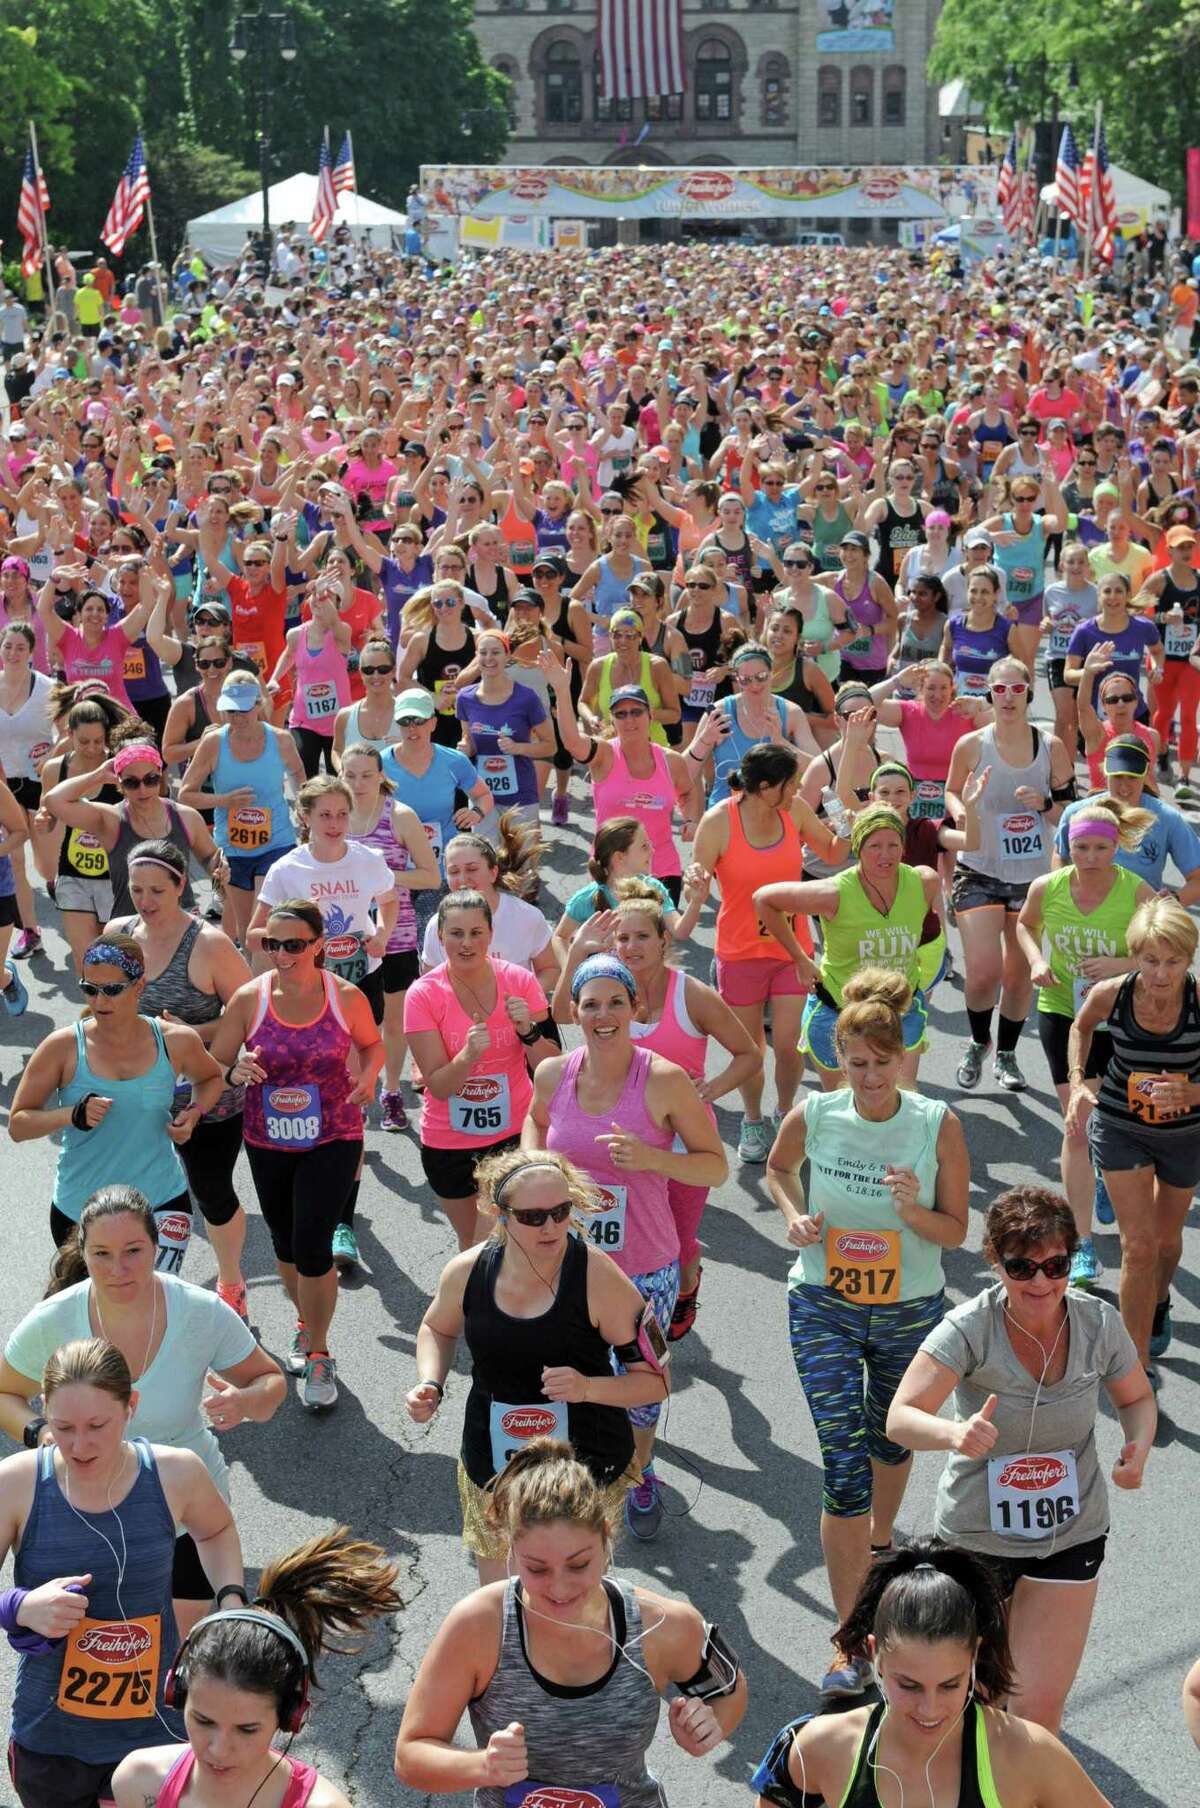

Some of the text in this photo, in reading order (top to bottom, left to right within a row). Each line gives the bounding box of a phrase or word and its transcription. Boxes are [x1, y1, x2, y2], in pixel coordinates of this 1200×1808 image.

[307, 697, 336, 715] 1167
[229, 827, 269, 845] 2616
[1002, 834, 1042, 854] 1024
[75, 851, 105, 870] 259
[310, 879, 360, 897] SNAIL
[865, 925, 911, 938] WE WILL
[1082, 926, 1109, 940] WILL
[858, 933, 918, 960] RUN
[1055, 932, 1117, 958] RUN
[459, 1105, 502, 1129] 765
[266, 1115, 320, 1141] 3008
[837, 1156, 867, 1171] Emily
[833, 1168, 851, 1180] FOR
[853, 1172, 870, 1184] THE
[846, 1184, 883, 1198] 6.18.16
[829, 1265, 897, 1296] 2317
[996, 1495, 1075, 1530] 1196
[64, 1666, 153, 1707] 2275
